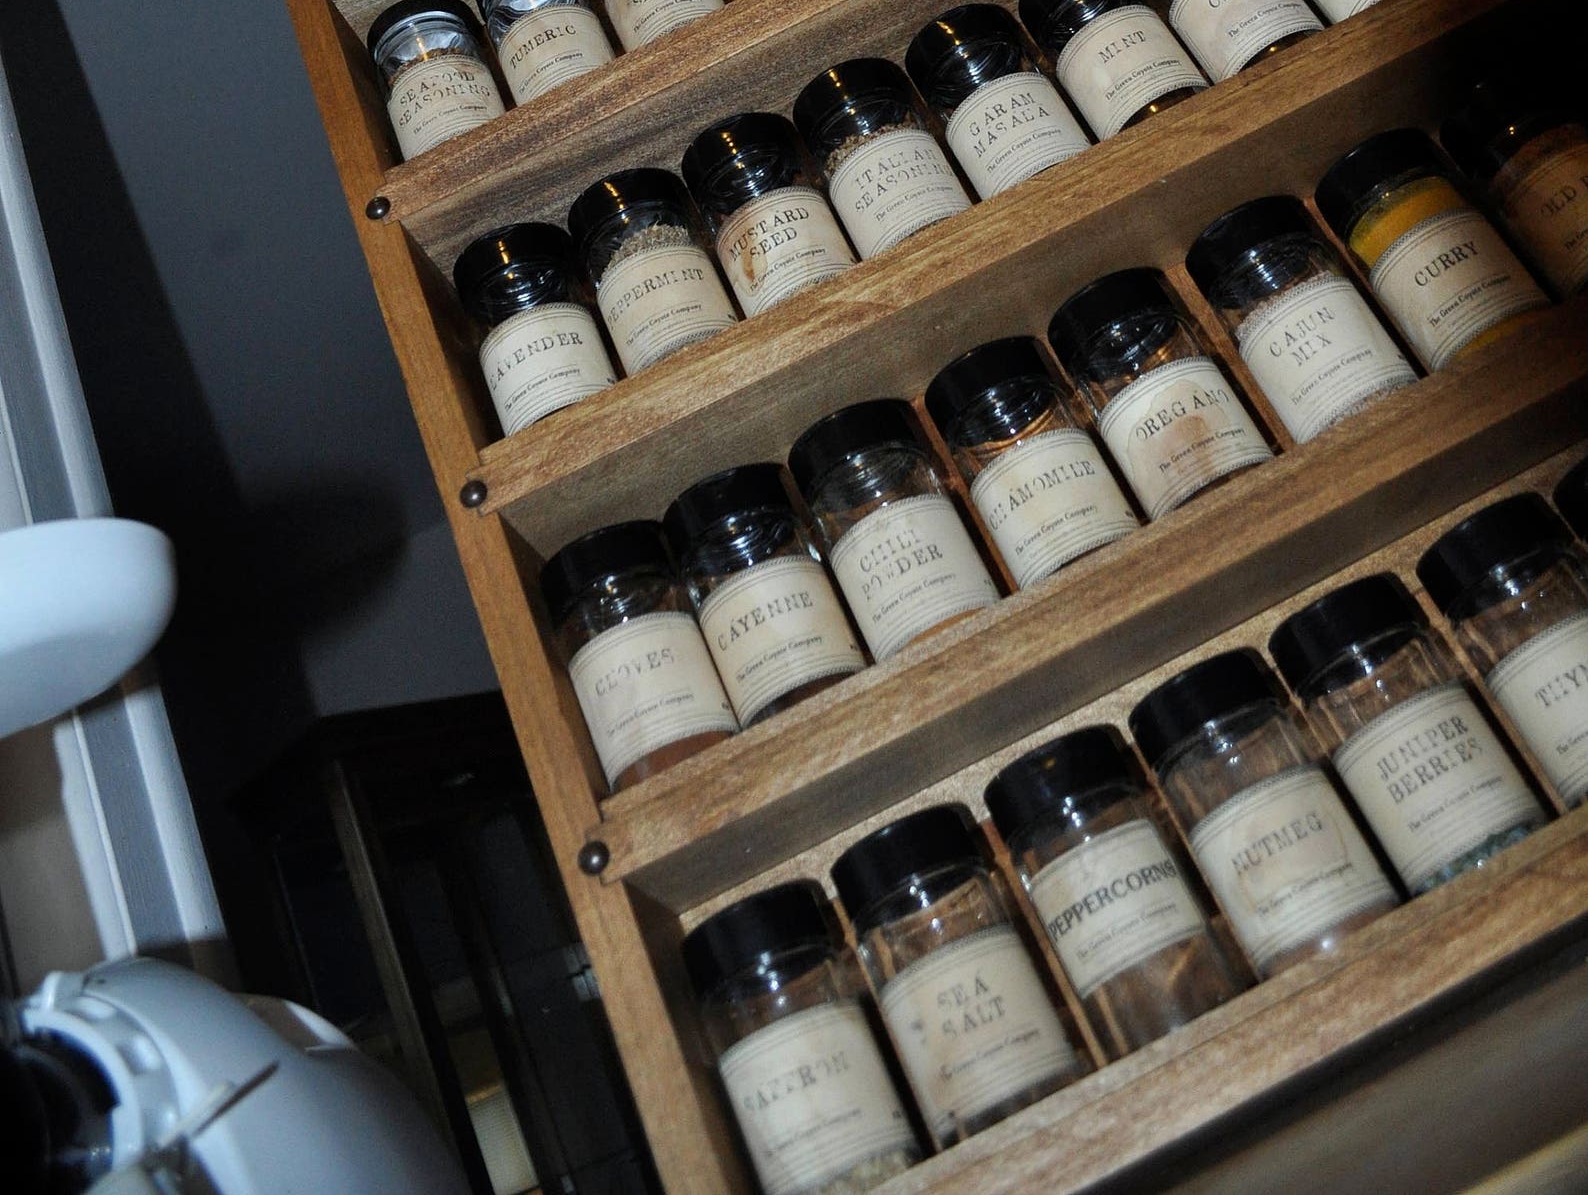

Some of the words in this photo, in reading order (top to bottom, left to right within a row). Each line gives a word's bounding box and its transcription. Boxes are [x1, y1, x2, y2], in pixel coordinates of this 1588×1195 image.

[509, 24, 577, 70] TUMERIC
[1098, 30, 1146, 63] MINT
[398, 84, 491, 128] SEASONING
[399, 71, 476, 108] SEAFOOD
[969, 92, 1037, 137] GARAM
[974, 106, 1051, 158] MASALA
[855, 163, 954, 213] SEASONING
[856, 149, 937, 189] ITALIAN
[729, 207, 809, 262] MUSTARD
[749, 227, 797, 258] SEED
[1414, 240, 1479, 287] CURRY
[607, 268, 705, 331] PEPPERMINT
[1428, 316, 1440, 328] The
[1440, 301, 1460, 318] Green
[1269, 307, 1336, 358] CAJUN
[1291, 334, 1333, 367] MIX
[489, 332, 583, 391] LAVENDER
[1135, 388, 1230, 441] OREGANO
[1159, 460, 1171, 473] The
[1171, 448, 1191, 464] Green
[1215, 428, 1247, 441] Company
[860, 528, 921, 573] CHILI
[861, 543, 943, 603] POWDER
[717, 590, 813, 652] CAYENNE
[595, 648, 675, 697] CLOVES
[1376, 716, 1468, 782] JUNIPER
[1386, 737, 1483, 805] BERRIES
[1231, 811, 1323, 876] NUTMEG
[1048, 858, 1178, 943] PEPPERCORNS
[937, 975, 989, 1008] SEA
[942, 995, 1006, 1038] SALT
